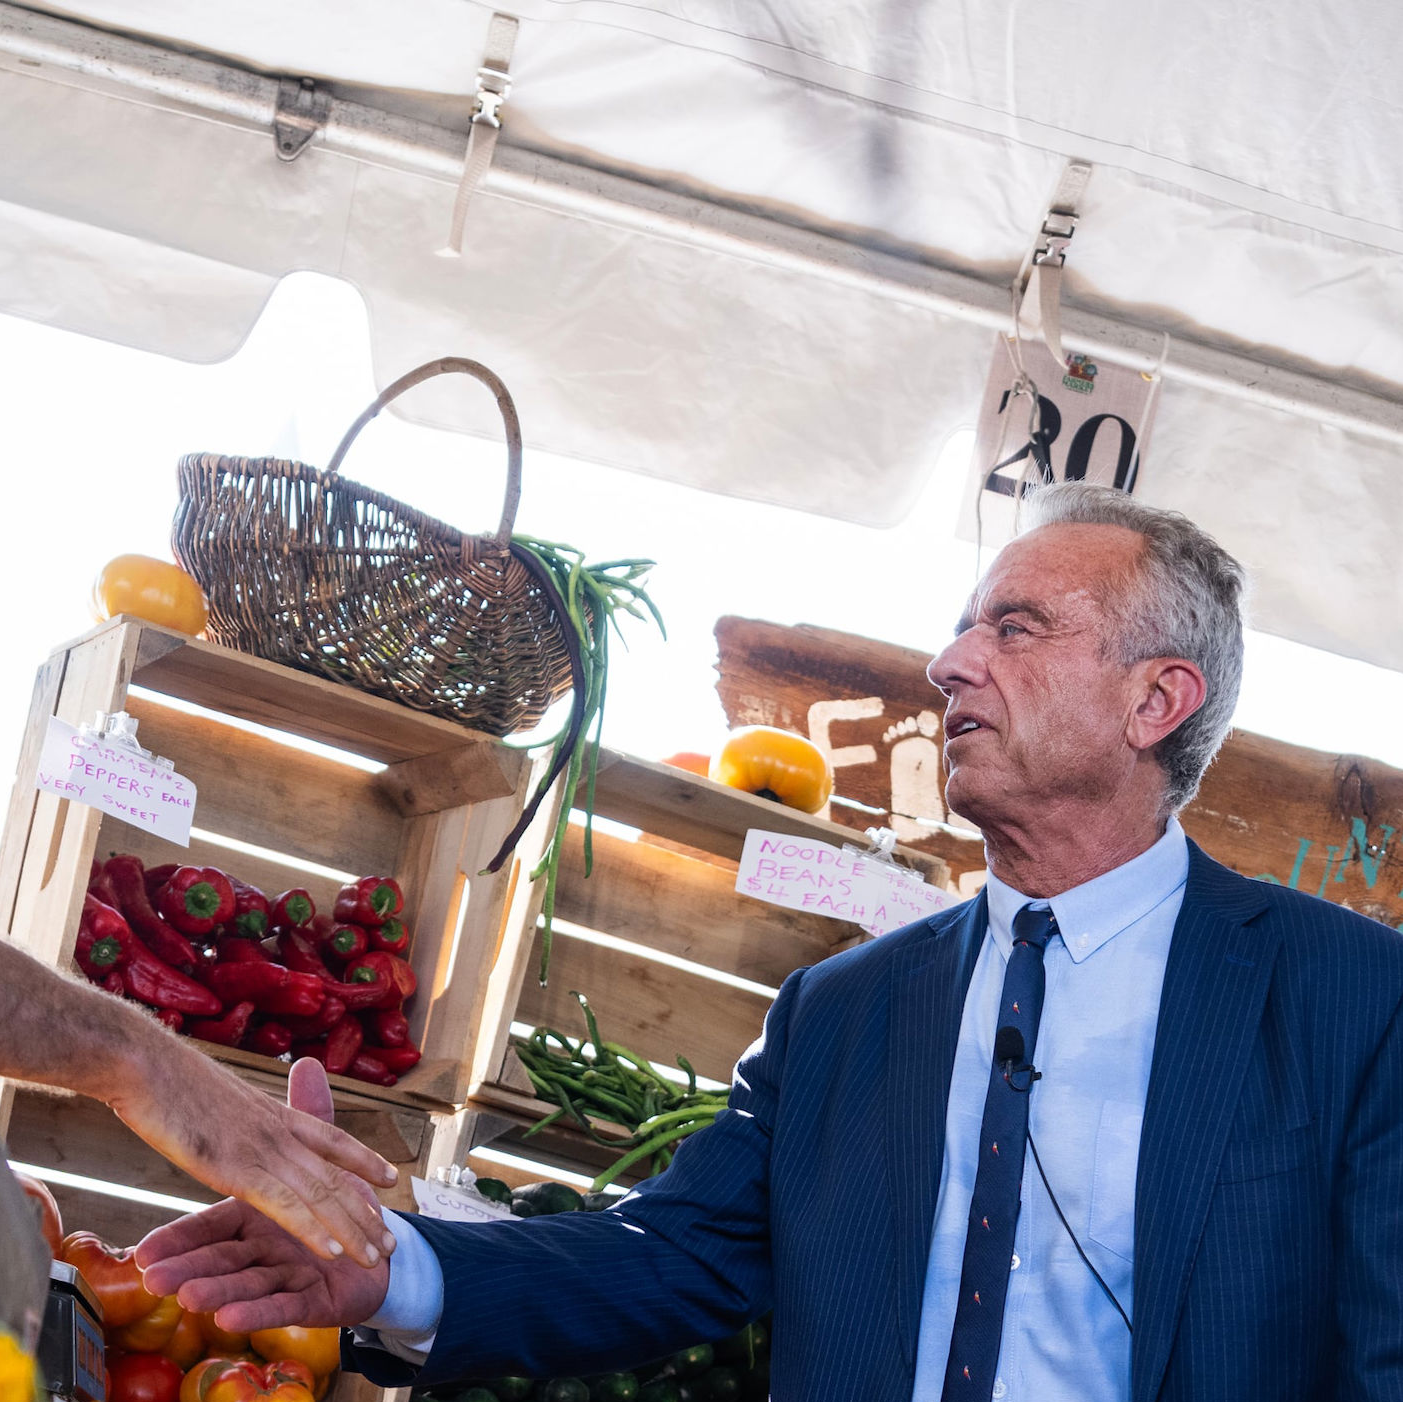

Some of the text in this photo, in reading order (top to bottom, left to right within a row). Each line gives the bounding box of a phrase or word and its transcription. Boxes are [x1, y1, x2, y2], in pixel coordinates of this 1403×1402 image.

[39, 772, 159, 824] VERY SWEET
[69, 754, 191, 809] PEPPERS EACH
[757, 859, 852, 896] BEANS
[760, 840, 866, 878] NOODLE
[746, 876, 865, 917] $4 EACH
